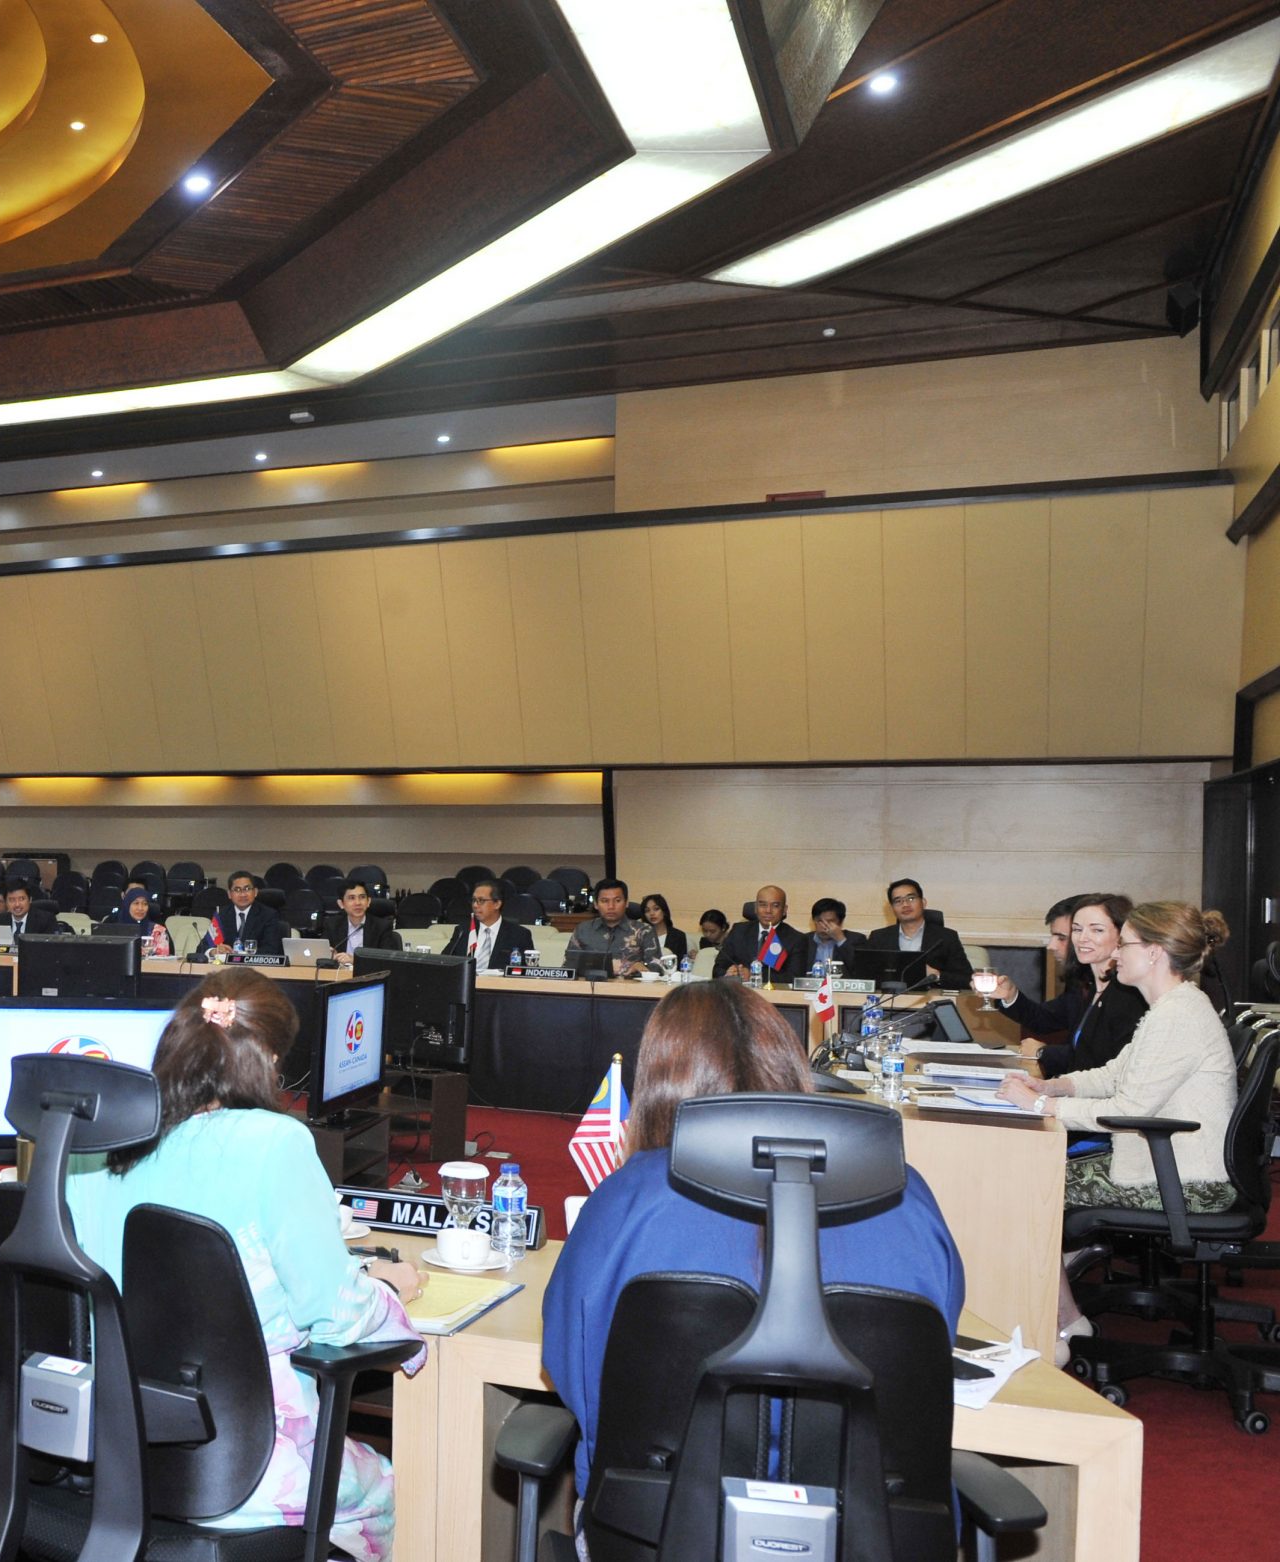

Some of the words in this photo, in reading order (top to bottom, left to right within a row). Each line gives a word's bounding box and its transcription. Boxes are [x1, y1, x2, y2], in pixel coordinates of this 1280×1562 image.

[243, 955, 280, 965] CAMBODIA
[525, 968, 569, 979] INDONESIA
[843, 981, 866, 991] PDR
